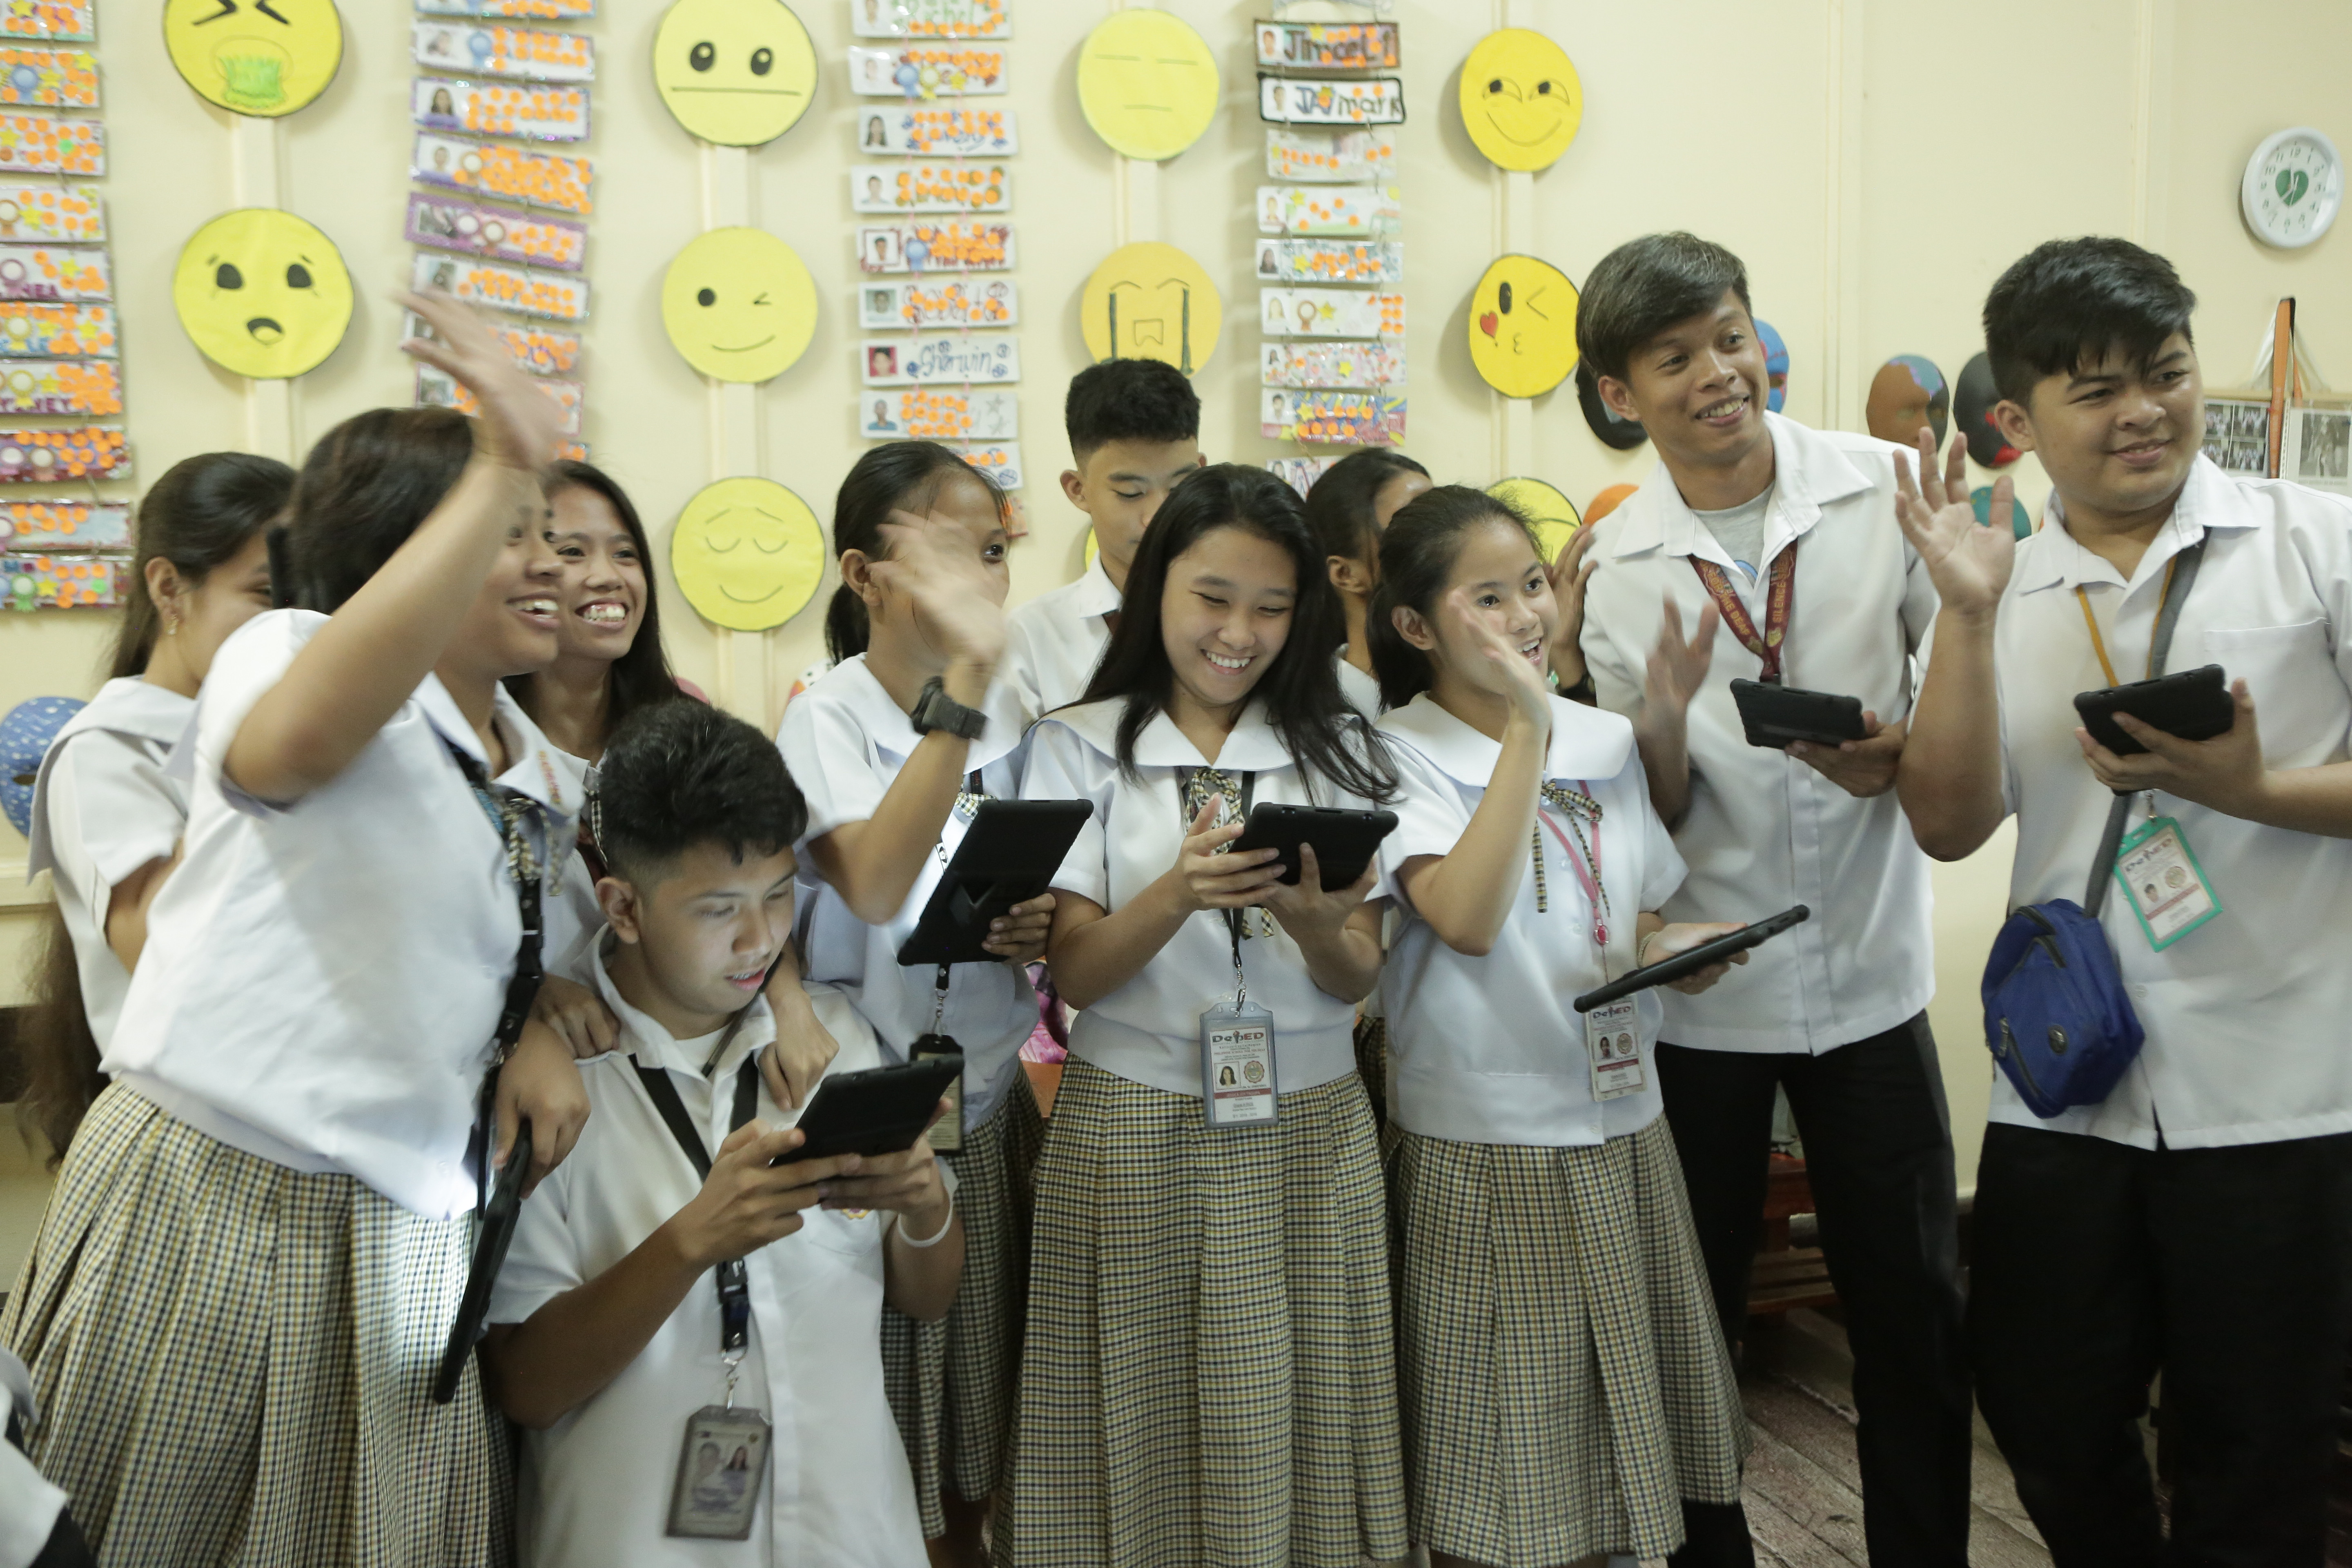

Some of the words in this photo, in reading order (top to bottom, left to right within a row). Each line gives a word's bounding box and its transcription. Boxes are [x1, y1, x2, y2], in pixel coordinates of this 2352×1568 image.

[1706, 572, 1724, 592] FOR
[1719, 592, 1735, 612] THE
[1731, 610, 1751, 636] DEAF
[1772, 581, 1786, 623] SILENCE
